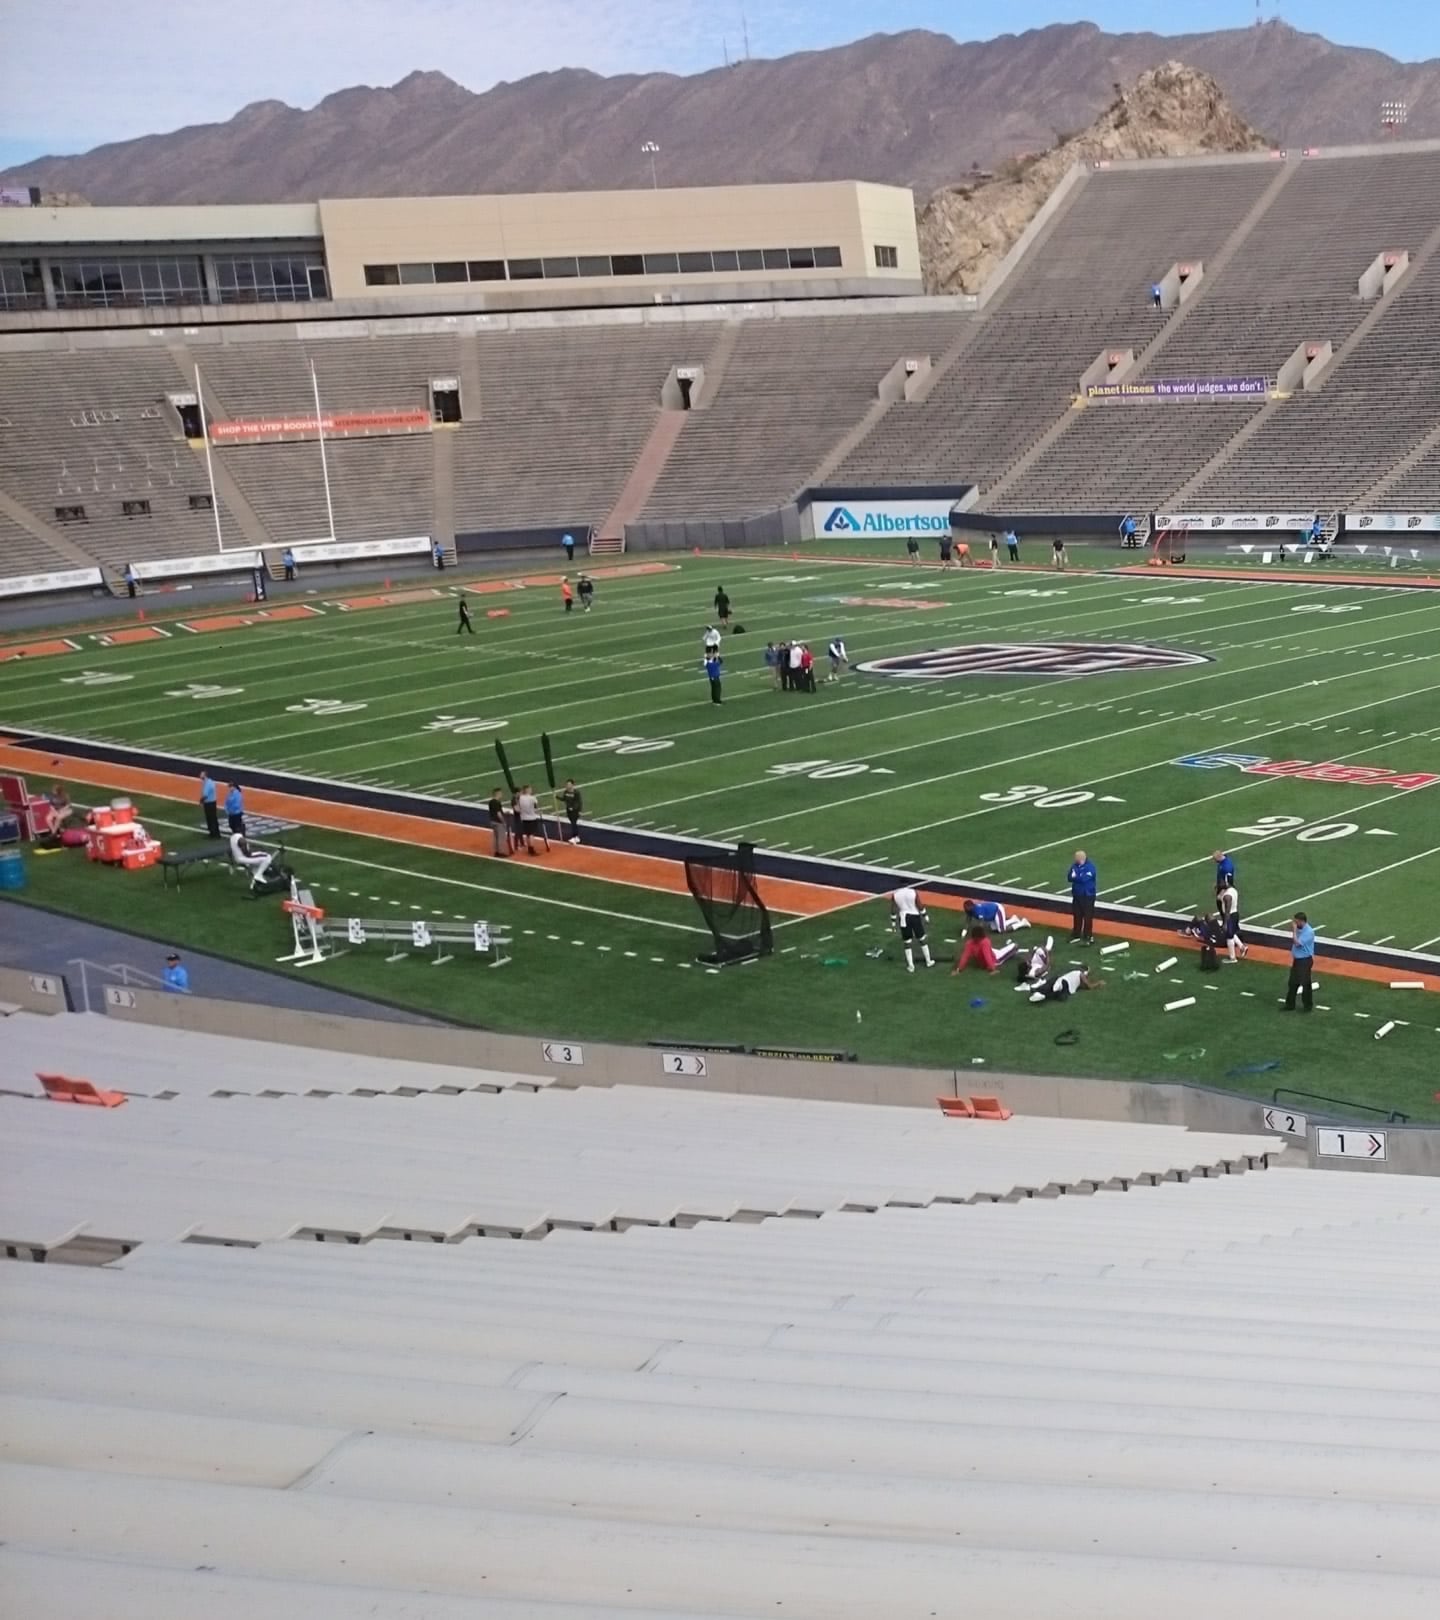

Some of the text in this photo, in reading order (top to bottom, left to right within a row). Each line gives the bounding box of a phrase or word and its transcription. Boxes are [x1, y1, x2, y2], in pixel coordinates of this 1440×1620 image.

[1088, 386, 1120, 396] planet
[1122, 385, 1155, 394] fitness
[1158, 384, 1172, 393] the
[1173, 383, 1195, 393] world
[1240, 382, 1264, 392] don't.
[218, 426, 241, 435] SHOP
[243, 425, 259, 433] THE
[261, 424, 282, 432] UTEP
[284, 420, 333, 432] BOOKSTORE
[576, 735, 675, 754] 50
[764, 760, 870, 779] 40
[979, 785, 1095, 808] 30
[1226, 815, 1360, 842] 20
[41, 979, 48, 993] 4
[114, 991, 121, 1004] 3
[563, 1047, 573, 1062] 3
[675, 1057, 684, 1072] 2
[1286, 1115, 1296, 1132] 2
[1337, 1134, 1346, 1153] 1
